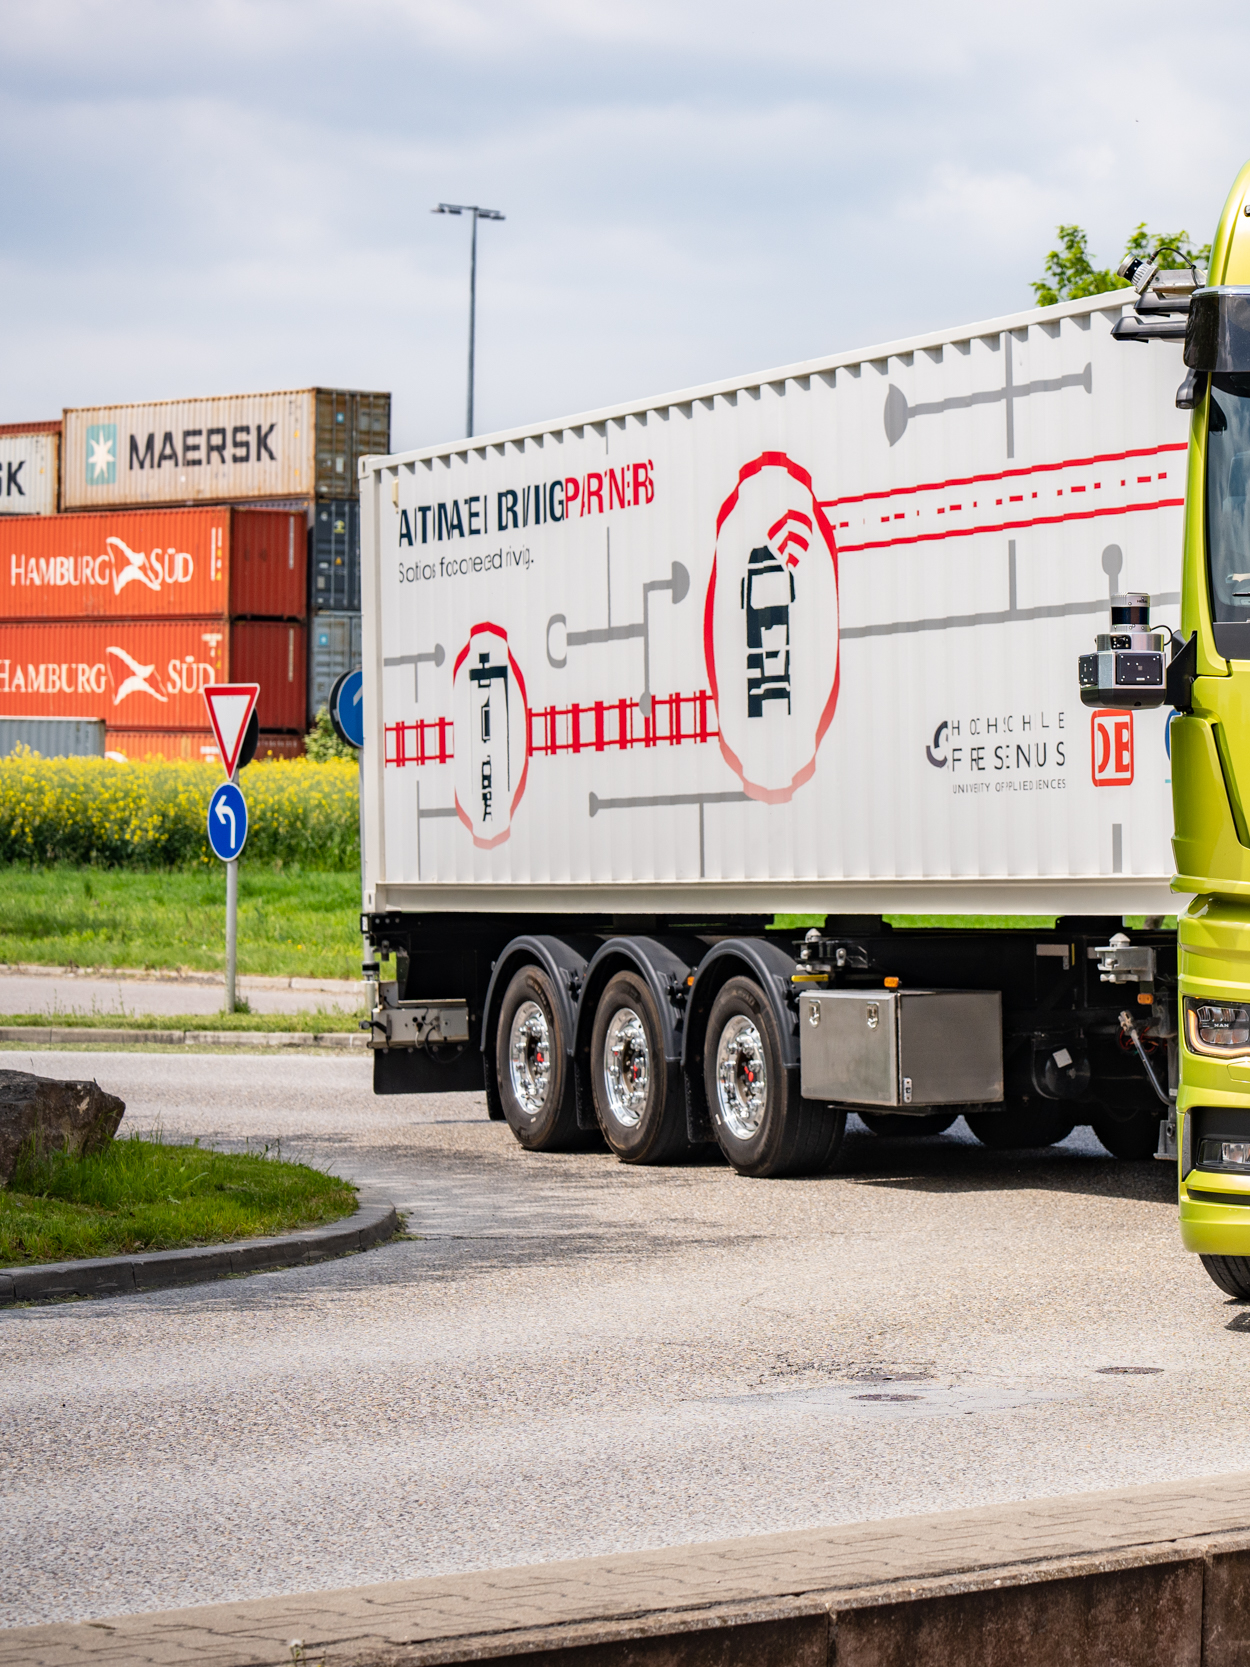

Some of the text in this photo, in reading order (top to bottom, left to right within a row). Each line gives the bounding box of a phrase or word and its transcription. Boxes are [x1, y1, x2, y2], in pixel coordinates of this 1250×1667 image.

[129, 422, 277, 471] MAERSK
[11, 553, 109, 587] HAMBURG
[150, 548, 194, 584] SÜD
[0, 655, 215, 694] HAMBURG SÜD
